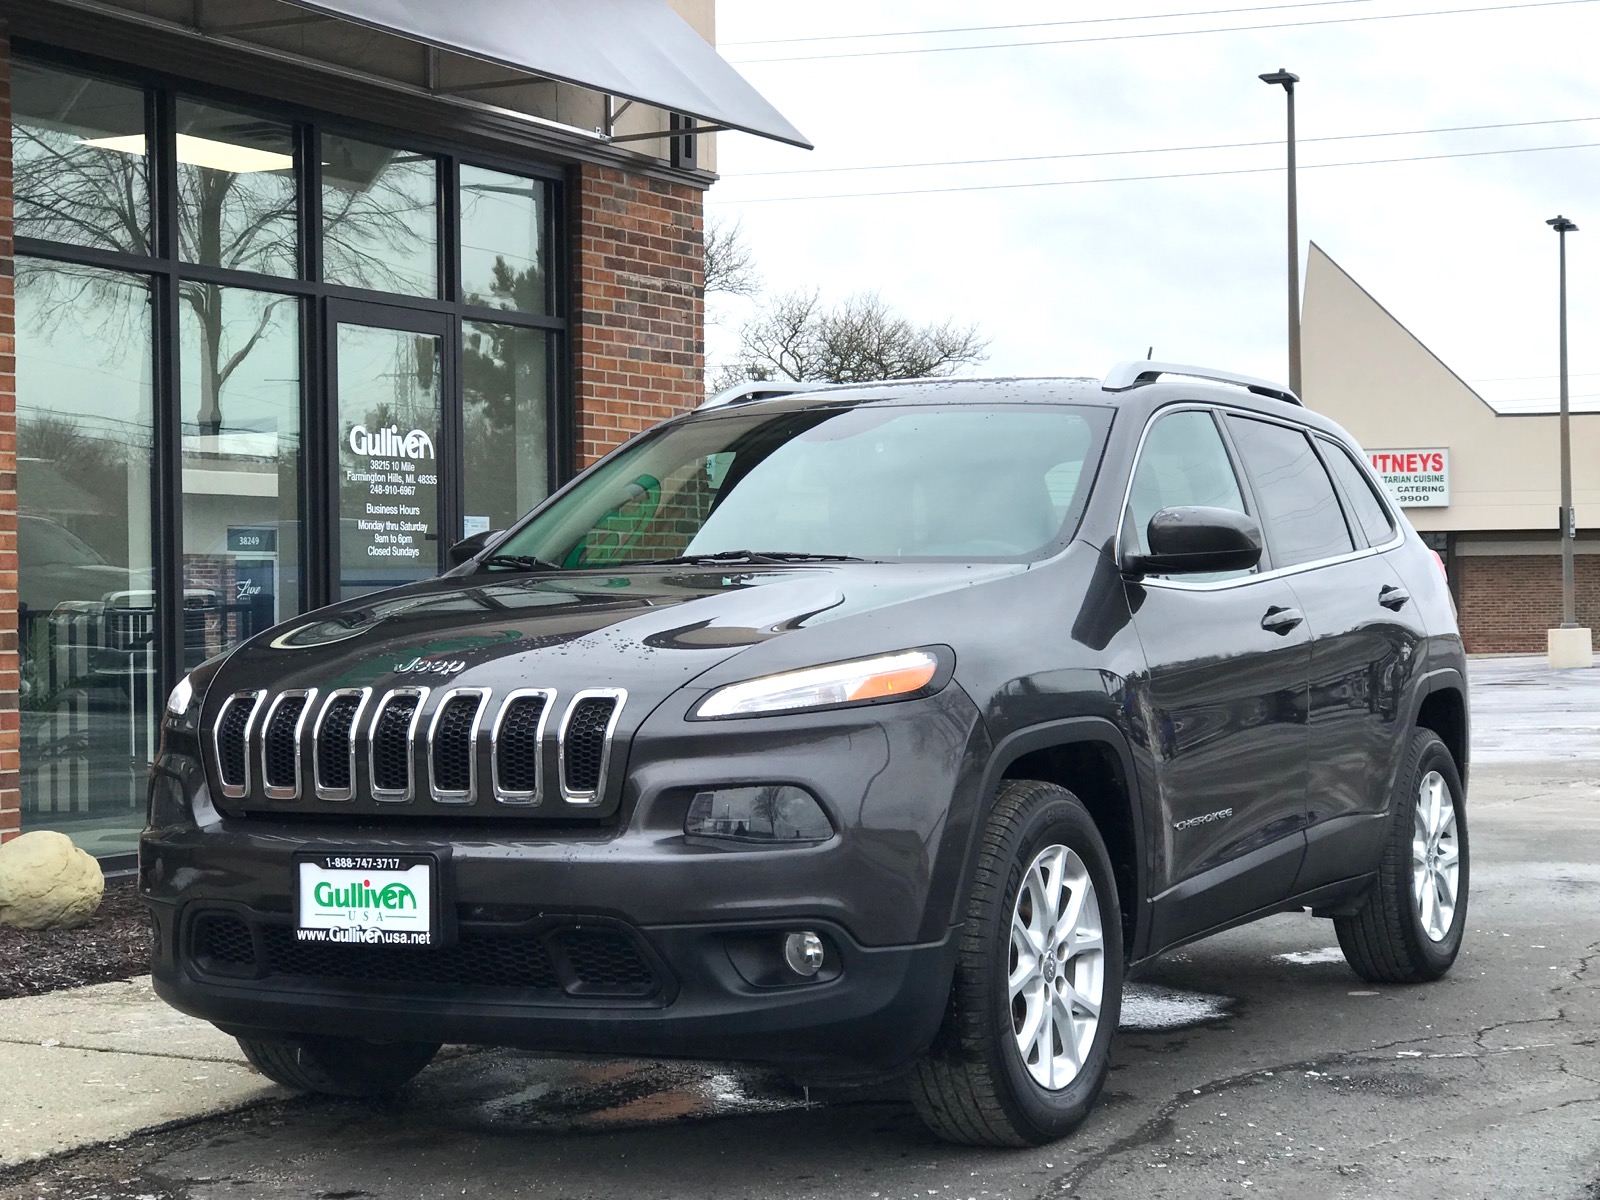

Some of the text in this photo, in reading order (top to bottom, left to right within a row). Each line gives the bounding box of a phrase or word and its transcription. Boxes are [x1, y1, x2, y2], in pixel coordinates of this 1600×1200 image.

[349, 424, 435, 459] Gulliver
[370, 460, 415, 472] 38215 10 Mile
[346, 470, 386, 484] Farmington
[387, 472, 404, 485] Hills,
[418, 474, 438, 485] 48335
[1381, 474, 1445, 484] TARIAN CUISINE
[370, 484, 416, 496] 248-910-6967
[1397, 485, 1445, 493] CATERING
[366, 502, 420, 516] Business Hours
[357, 519, 428, 534] Monday thru Saturday
[239, 536, 260, 545] 38249
[374, 533, 413, 546] 9am to 6pm
[367, 545, 420, 559] Closed Sundays
[325, 857, 400, 869] 1-888-747-3717
[314, 879, 417, 910] Gulliver
[348, 910, 384, 922] USA
[297, 925, 431, 945] www.Gulliverusa.net
